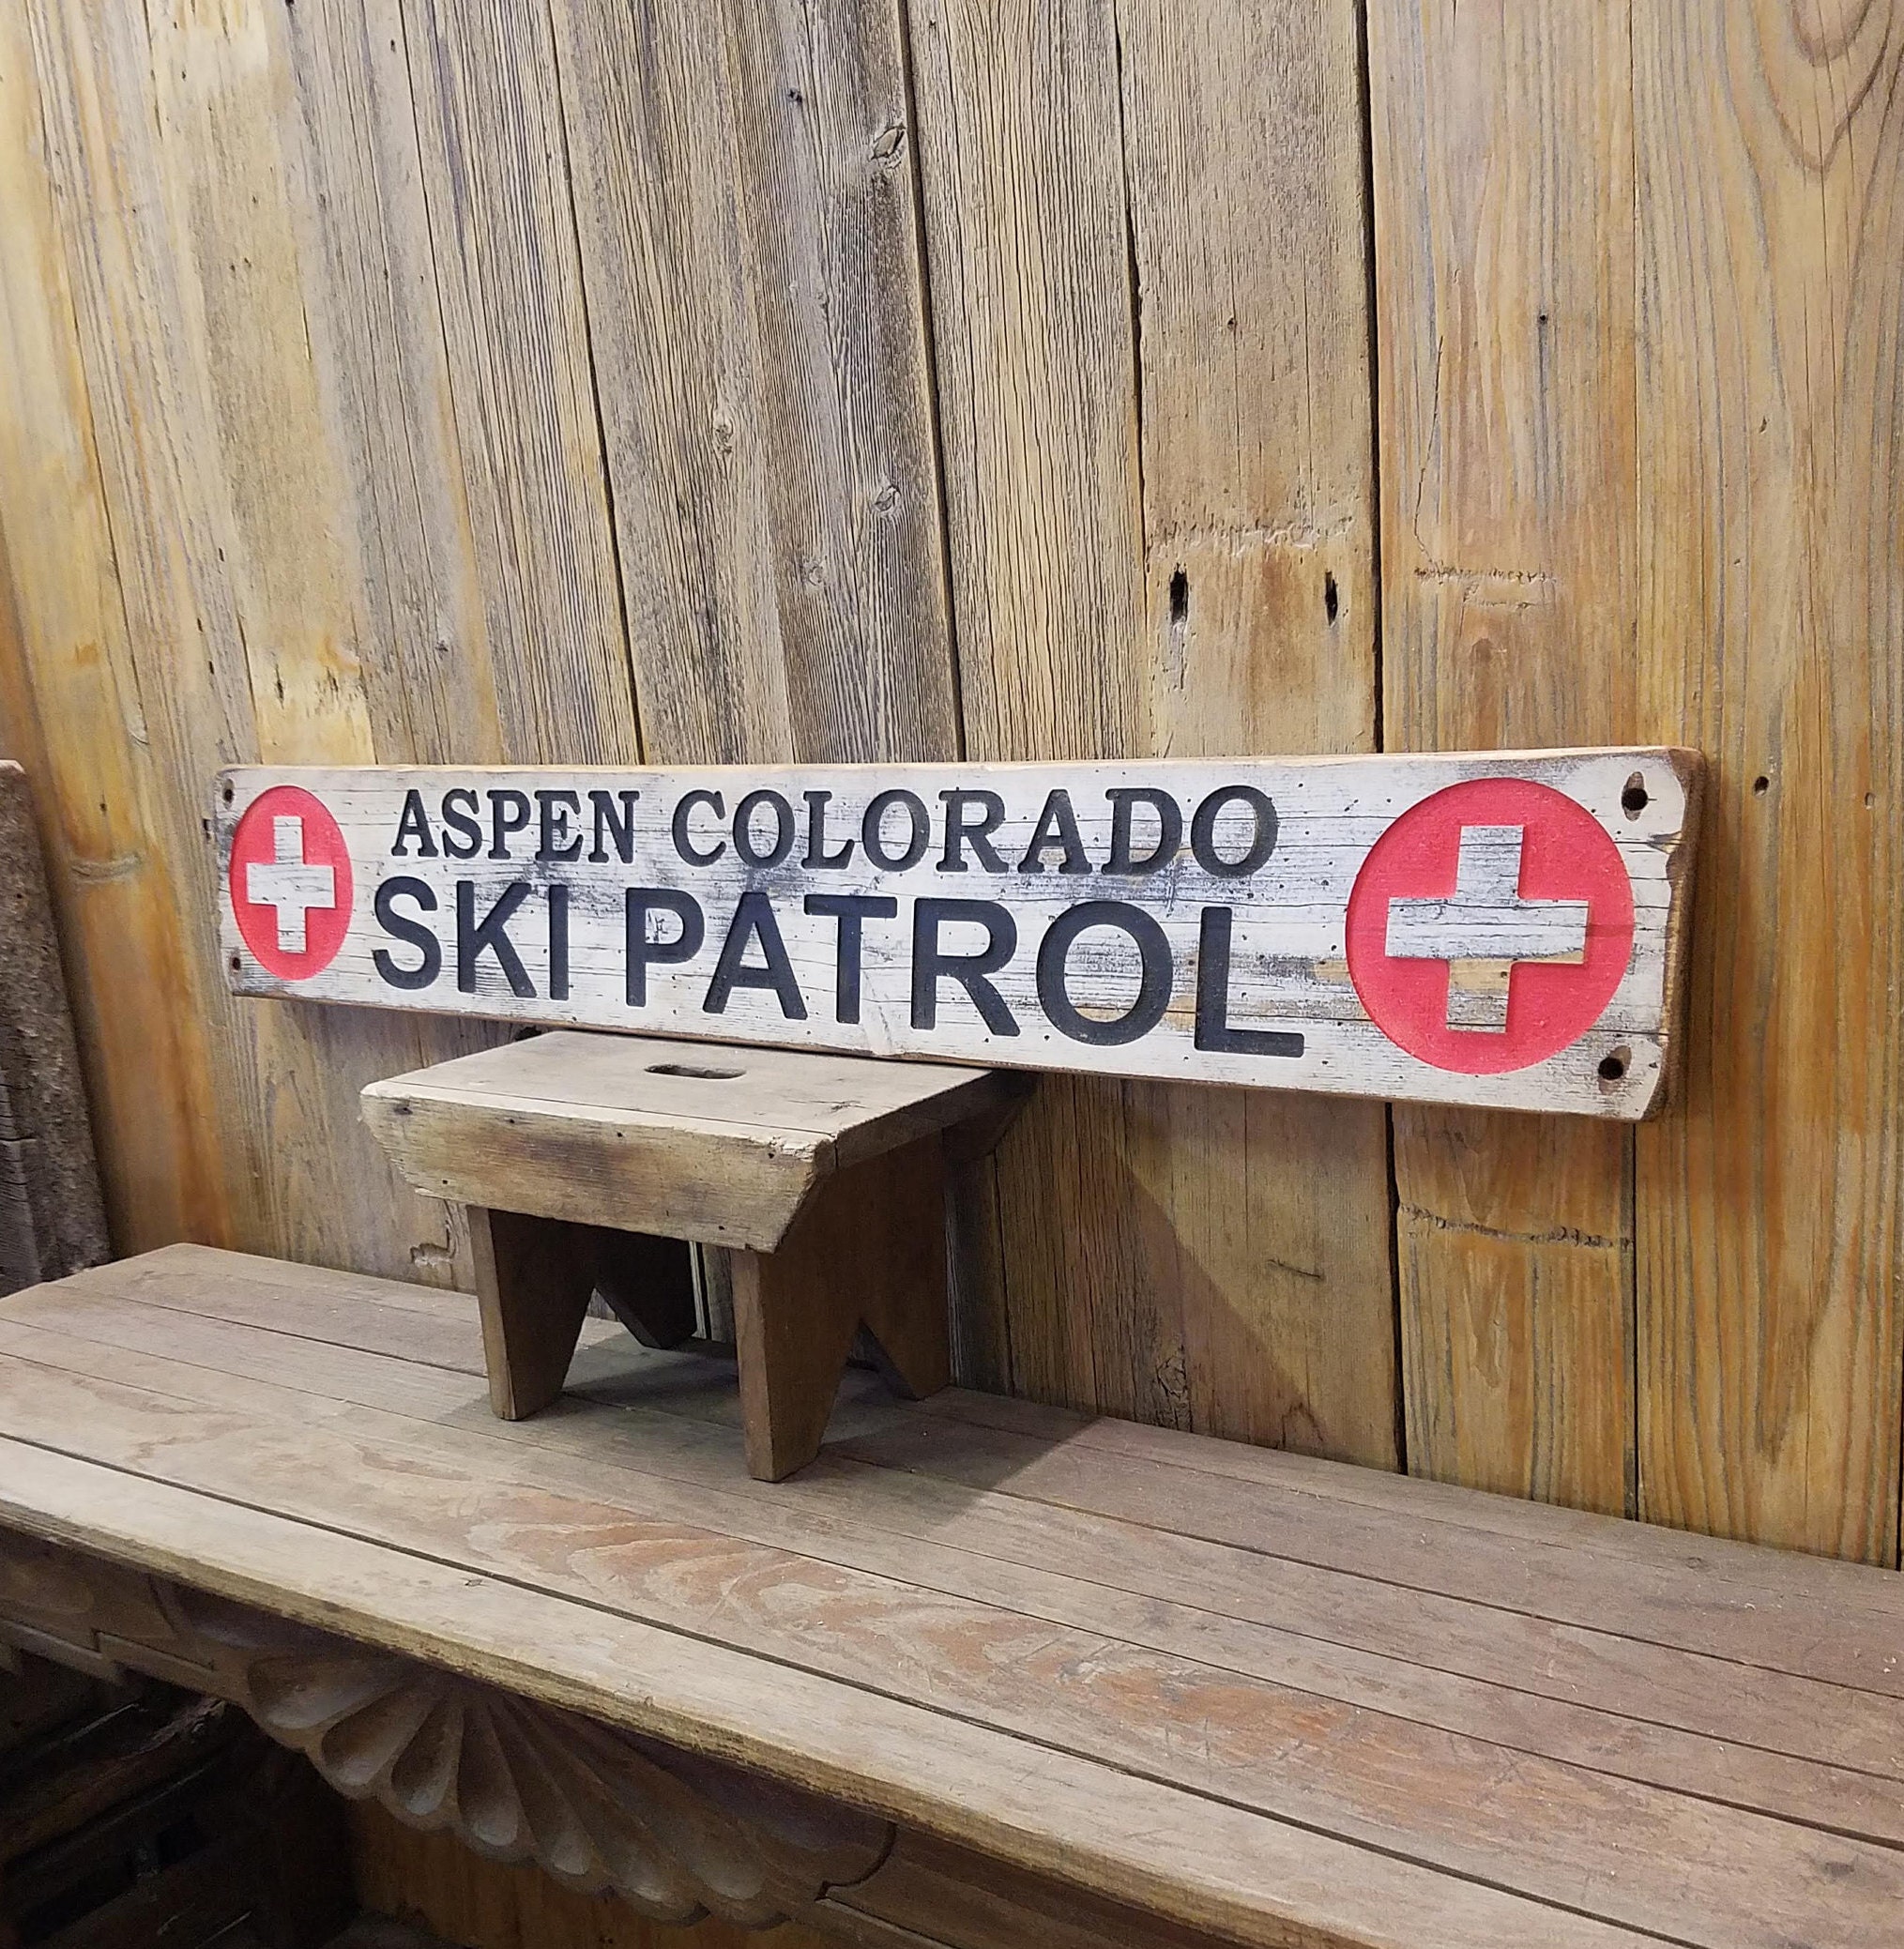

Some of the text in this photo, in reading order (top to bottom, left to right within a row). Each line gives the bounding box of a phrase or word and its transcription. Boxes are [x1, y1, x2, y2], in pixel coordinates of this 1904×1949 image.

[391, 784, 1279, 878] ASPEN COLORADO
[373, 876, 1305, 1058] SKI PATROL
